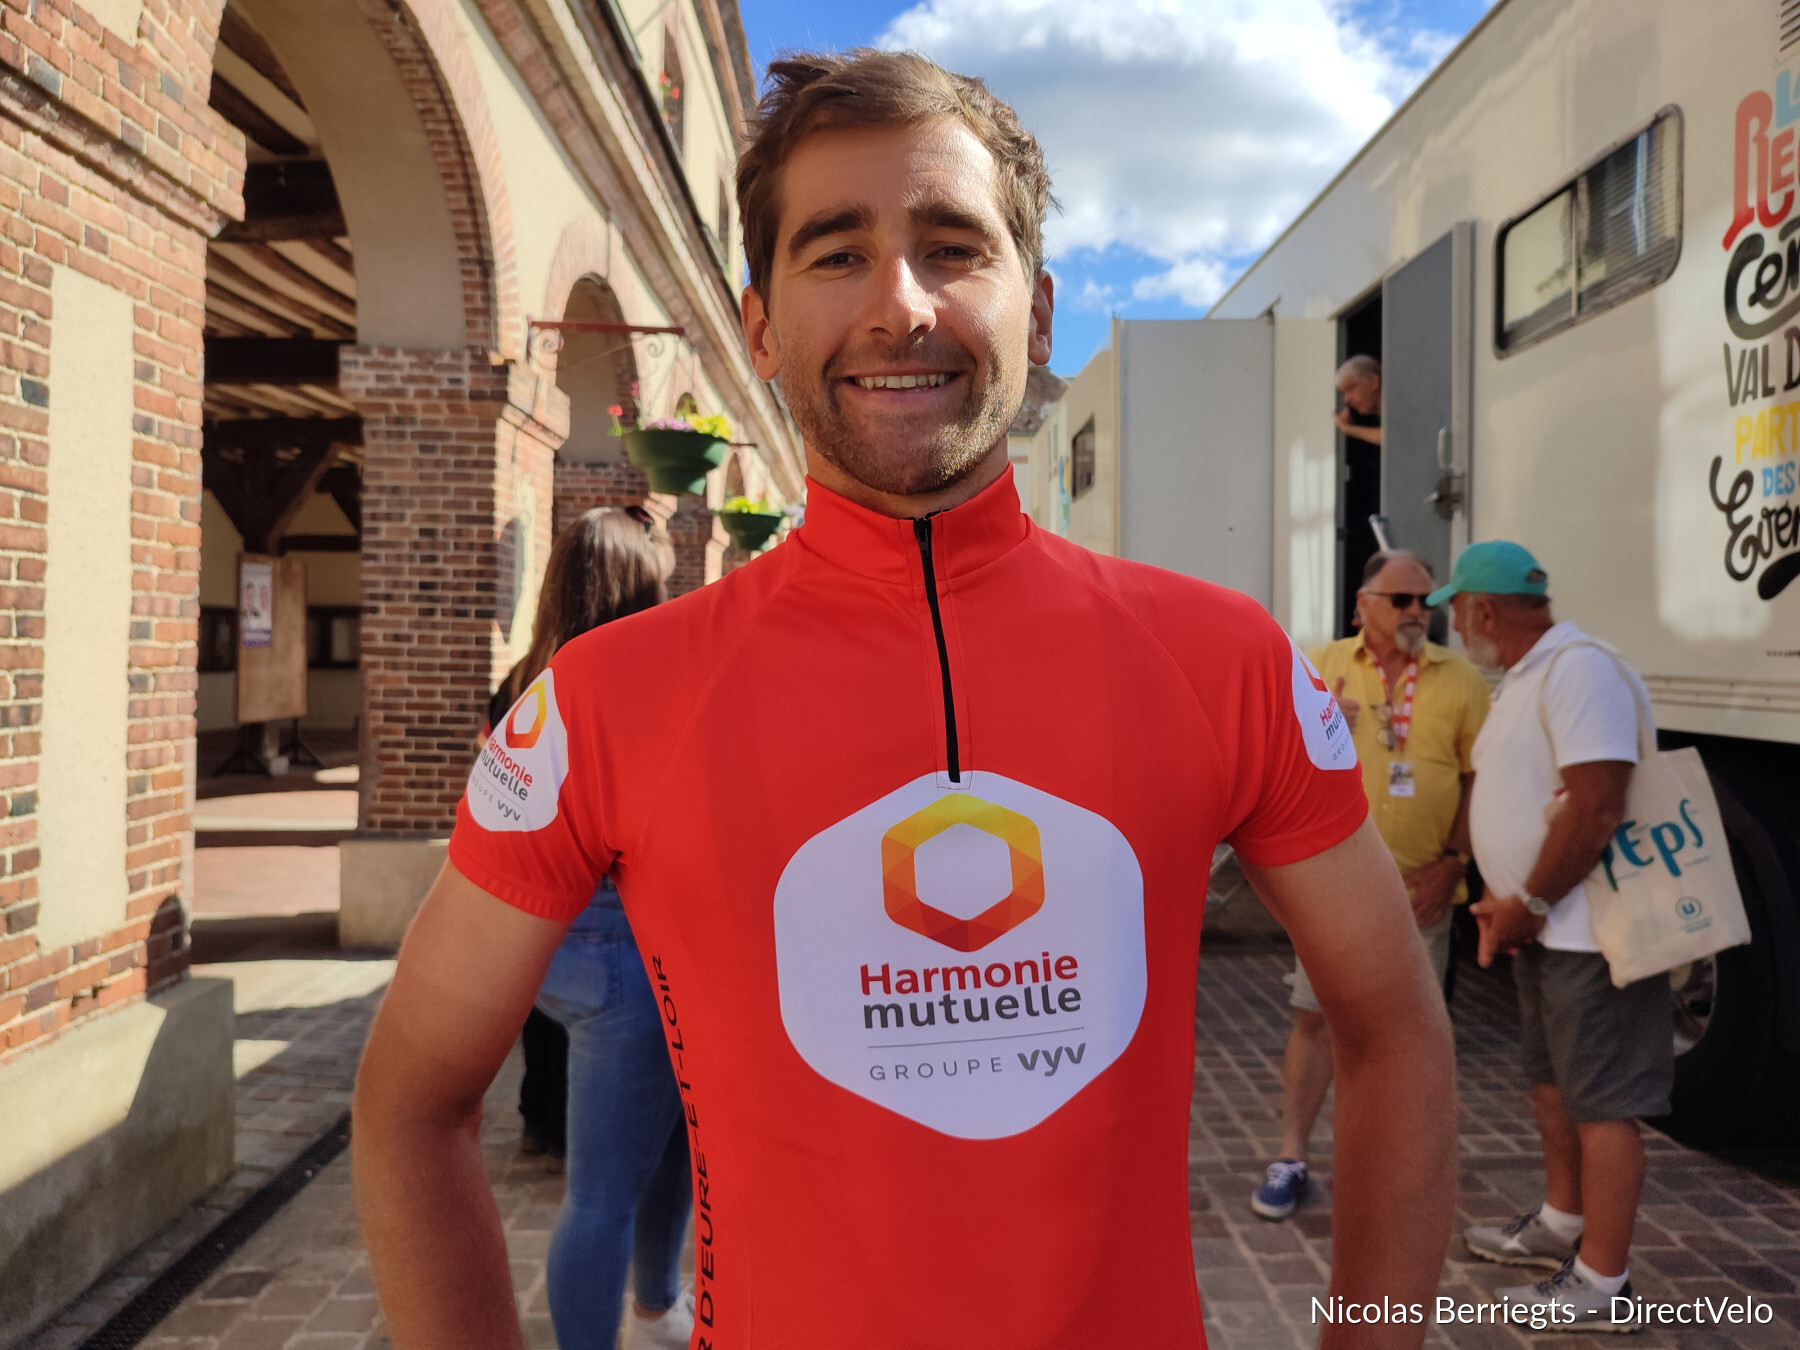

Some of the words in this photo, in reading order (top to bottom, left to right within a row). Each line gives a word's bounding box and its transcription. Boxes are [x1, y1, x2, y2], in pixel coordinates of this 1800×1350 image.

[1723, 342, 1775, 408] VAL
[1761, 461, 1795, 498] DES
[497, 799, 522, 821] vyv
[860, 951, 1079, 996] Harmonie
[863, 984, 1082, 1029] mutuelle
[869, 1057, 1003, 1081] GROUPE
[1016, 1042, 1087, 1077] vyv
